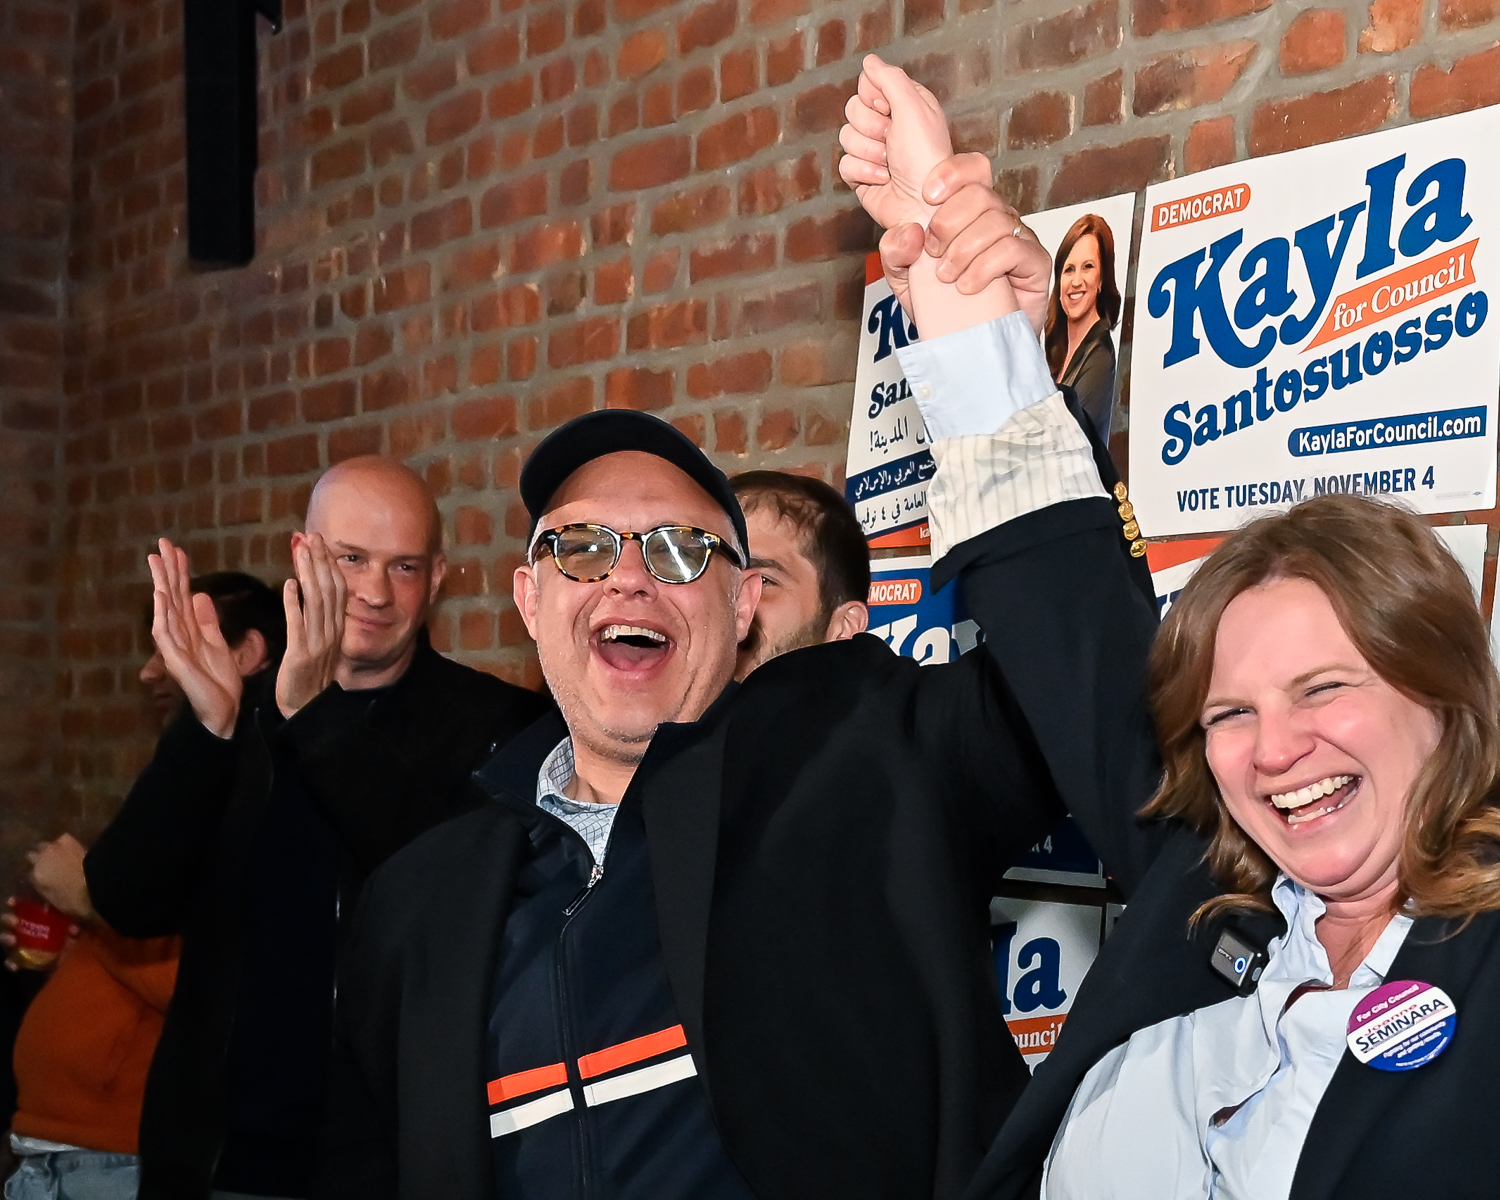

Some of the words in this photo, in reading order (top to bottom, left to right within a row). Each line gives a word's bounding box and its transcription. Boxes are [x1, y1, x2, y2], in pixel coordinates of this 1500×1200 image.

[1158, 189, 1245, 224] DEMOCRAT
[1148, 153, 1473, 369] Kayla
[1333, 298, 1367, 332] for
[1371, 253, 1466, 314] Council
[1162, 291, 1489, 466] Santosuosso
[1298, 414, 1481, 456] KaylaForCouncil.com
[1177, 487, 1219, 512] VOTE
[1314, 467, 1416, 497] NOVEMBER
[1422, 466, 1435, 489] 4
[868, 582, 917, 603] MOCRAT
[1355, 998, 1447, 1052] SEMINARA
[1356, 1009, 1371, 1023] For
[1371, 1001, 1389, 1014] City
[1388, 984, 1420, 1004] Council
